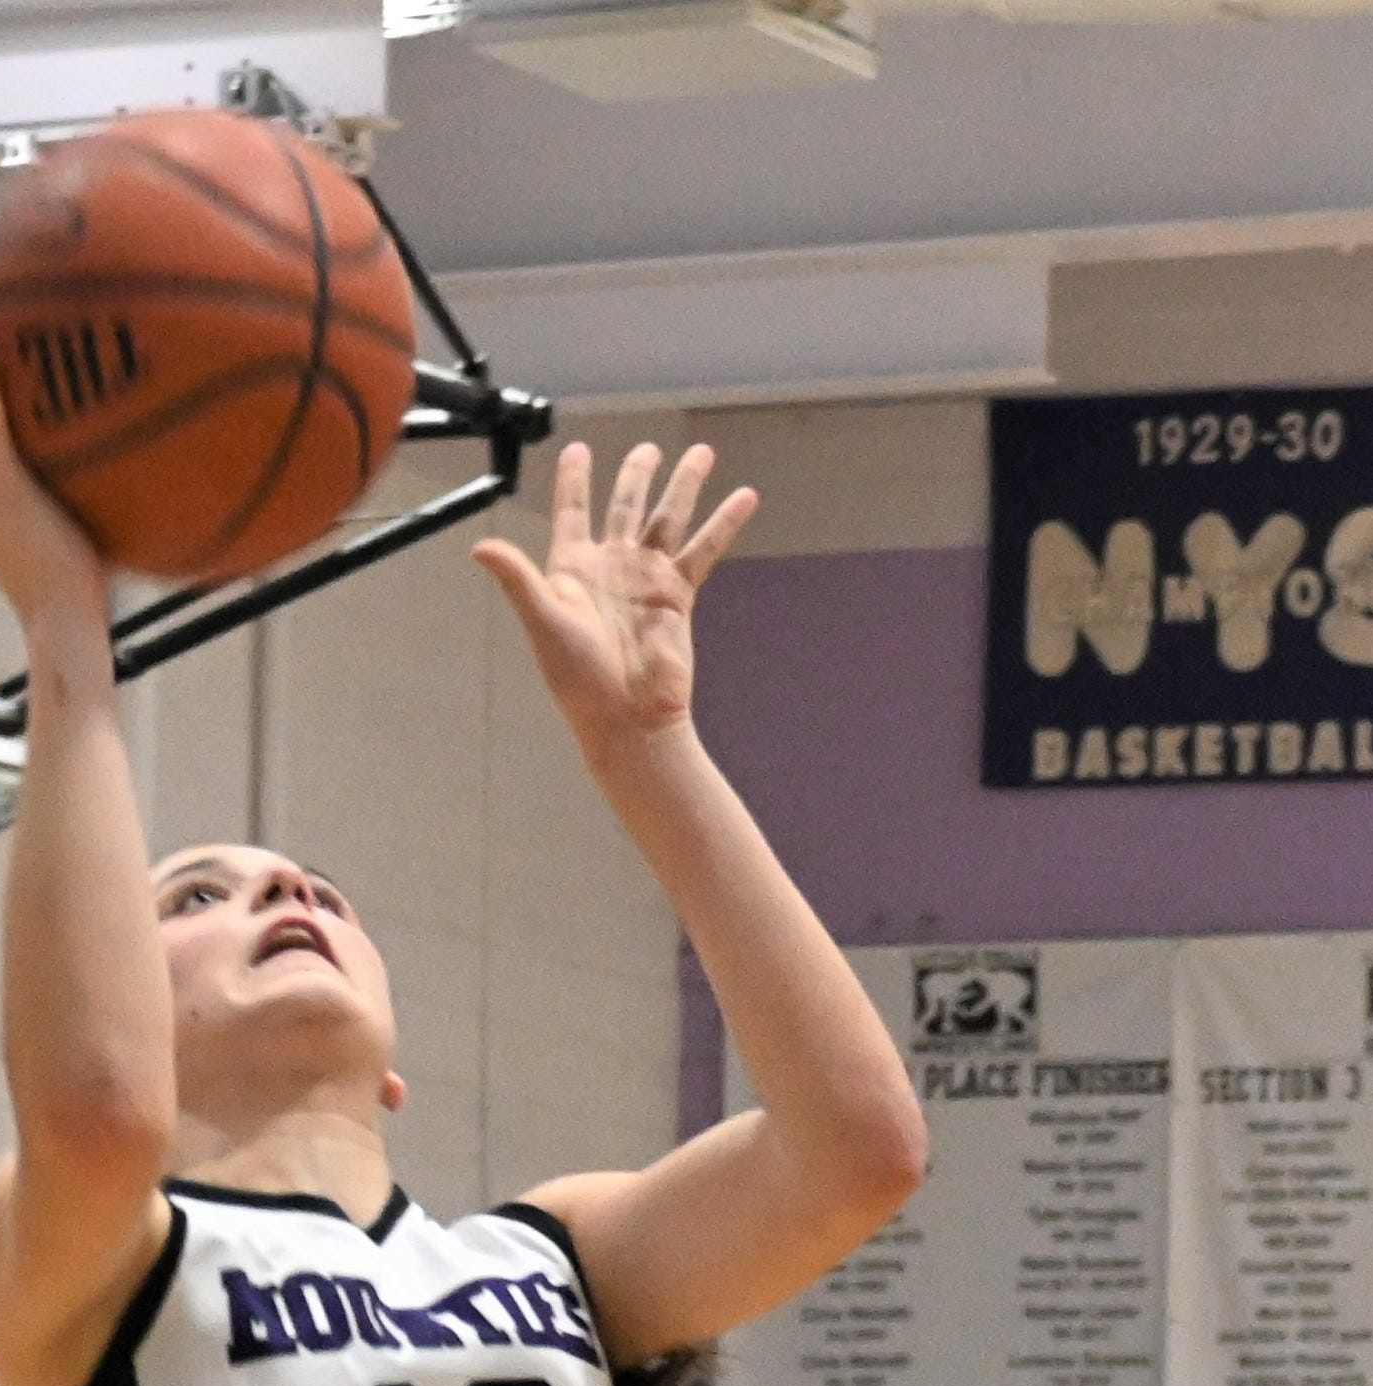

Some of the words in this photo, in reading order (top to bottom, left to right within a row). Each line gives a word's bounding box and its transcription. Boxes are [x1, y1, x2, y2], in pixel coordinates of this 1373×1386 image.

[1135, 410, 1345, 465] 1929-30
[925, 1062, 1020, 1100] PLACE
[1200, 1065, 1327, 1103] SECTION
